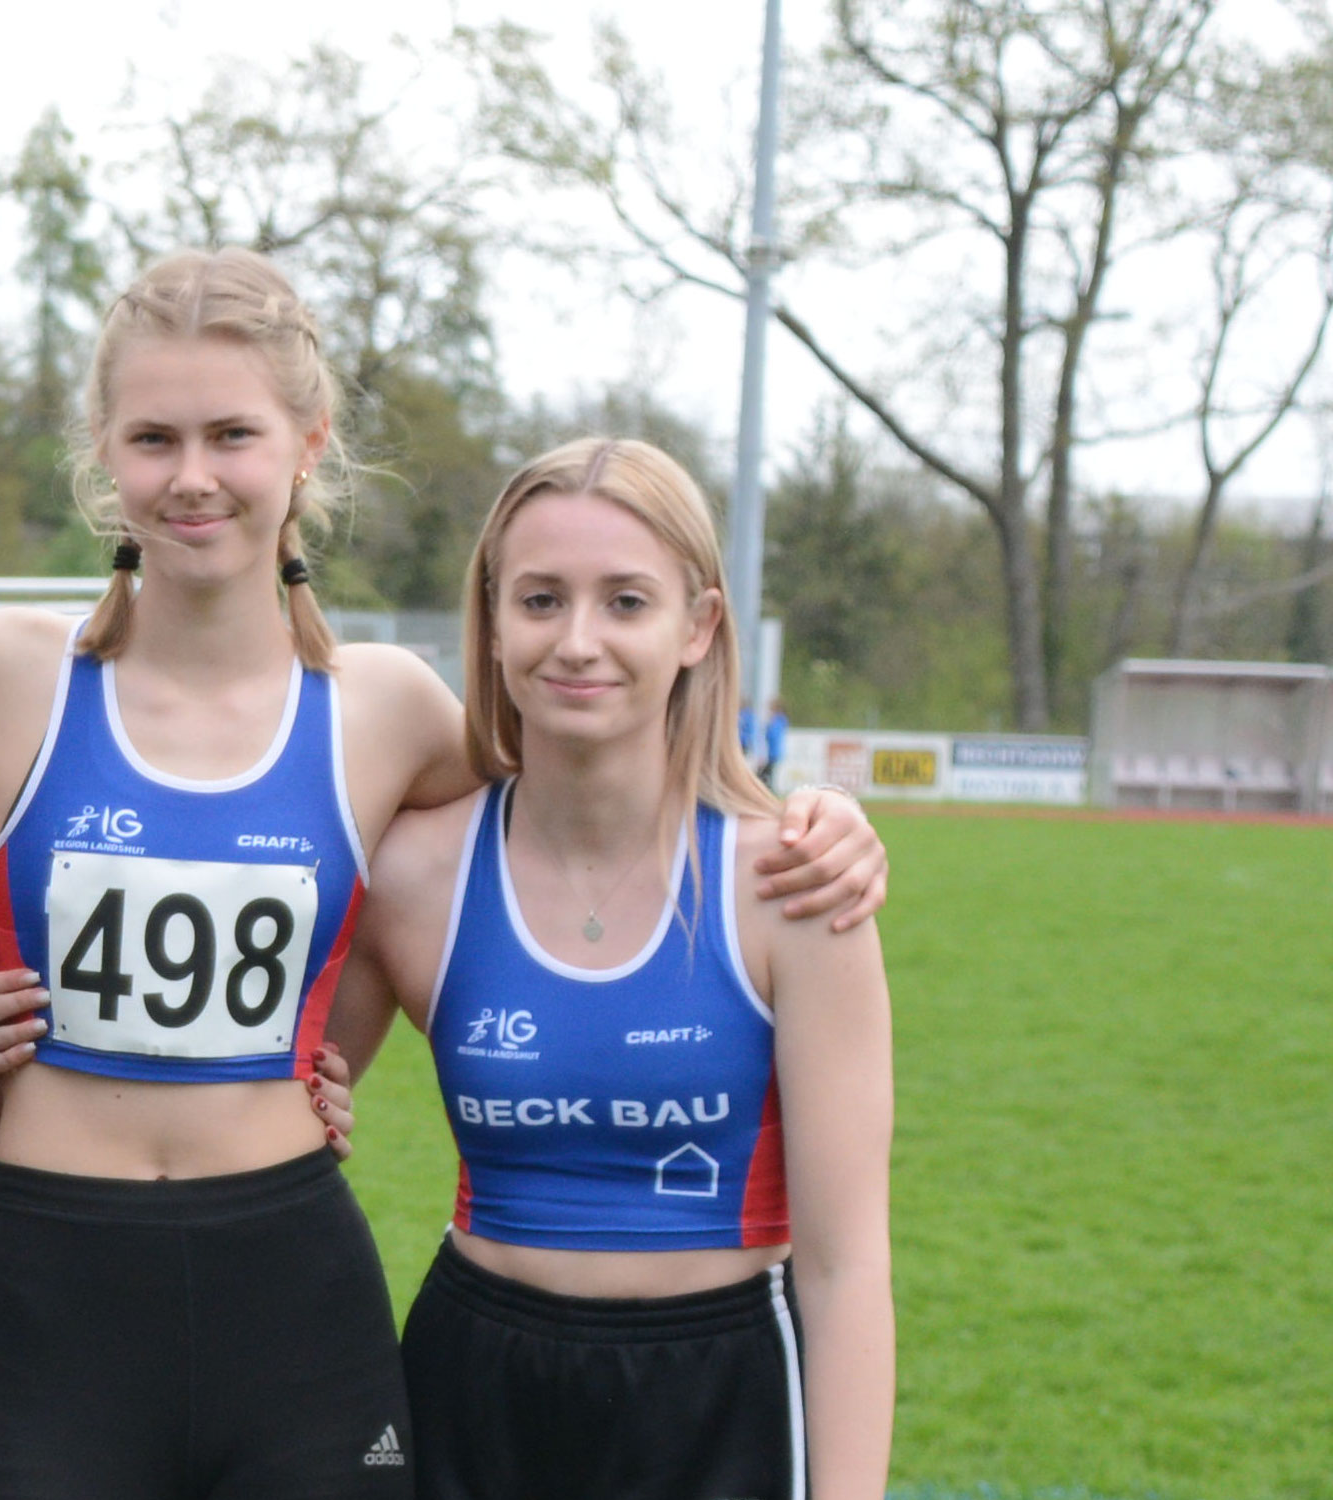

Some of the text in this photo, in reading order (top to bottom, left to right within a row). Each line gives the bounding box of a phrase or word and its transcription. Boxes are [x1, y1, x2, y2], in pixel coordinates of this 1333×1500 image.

[54, 840, 146, 856] REGION LANDSHUT
[237, 835, 298, 849] CRAFT
[60, 887, 295, 1029] 498
[625, 1027, 693, 1044] CRAFT
[457, 1092, 731, 1127] BECK BAU
